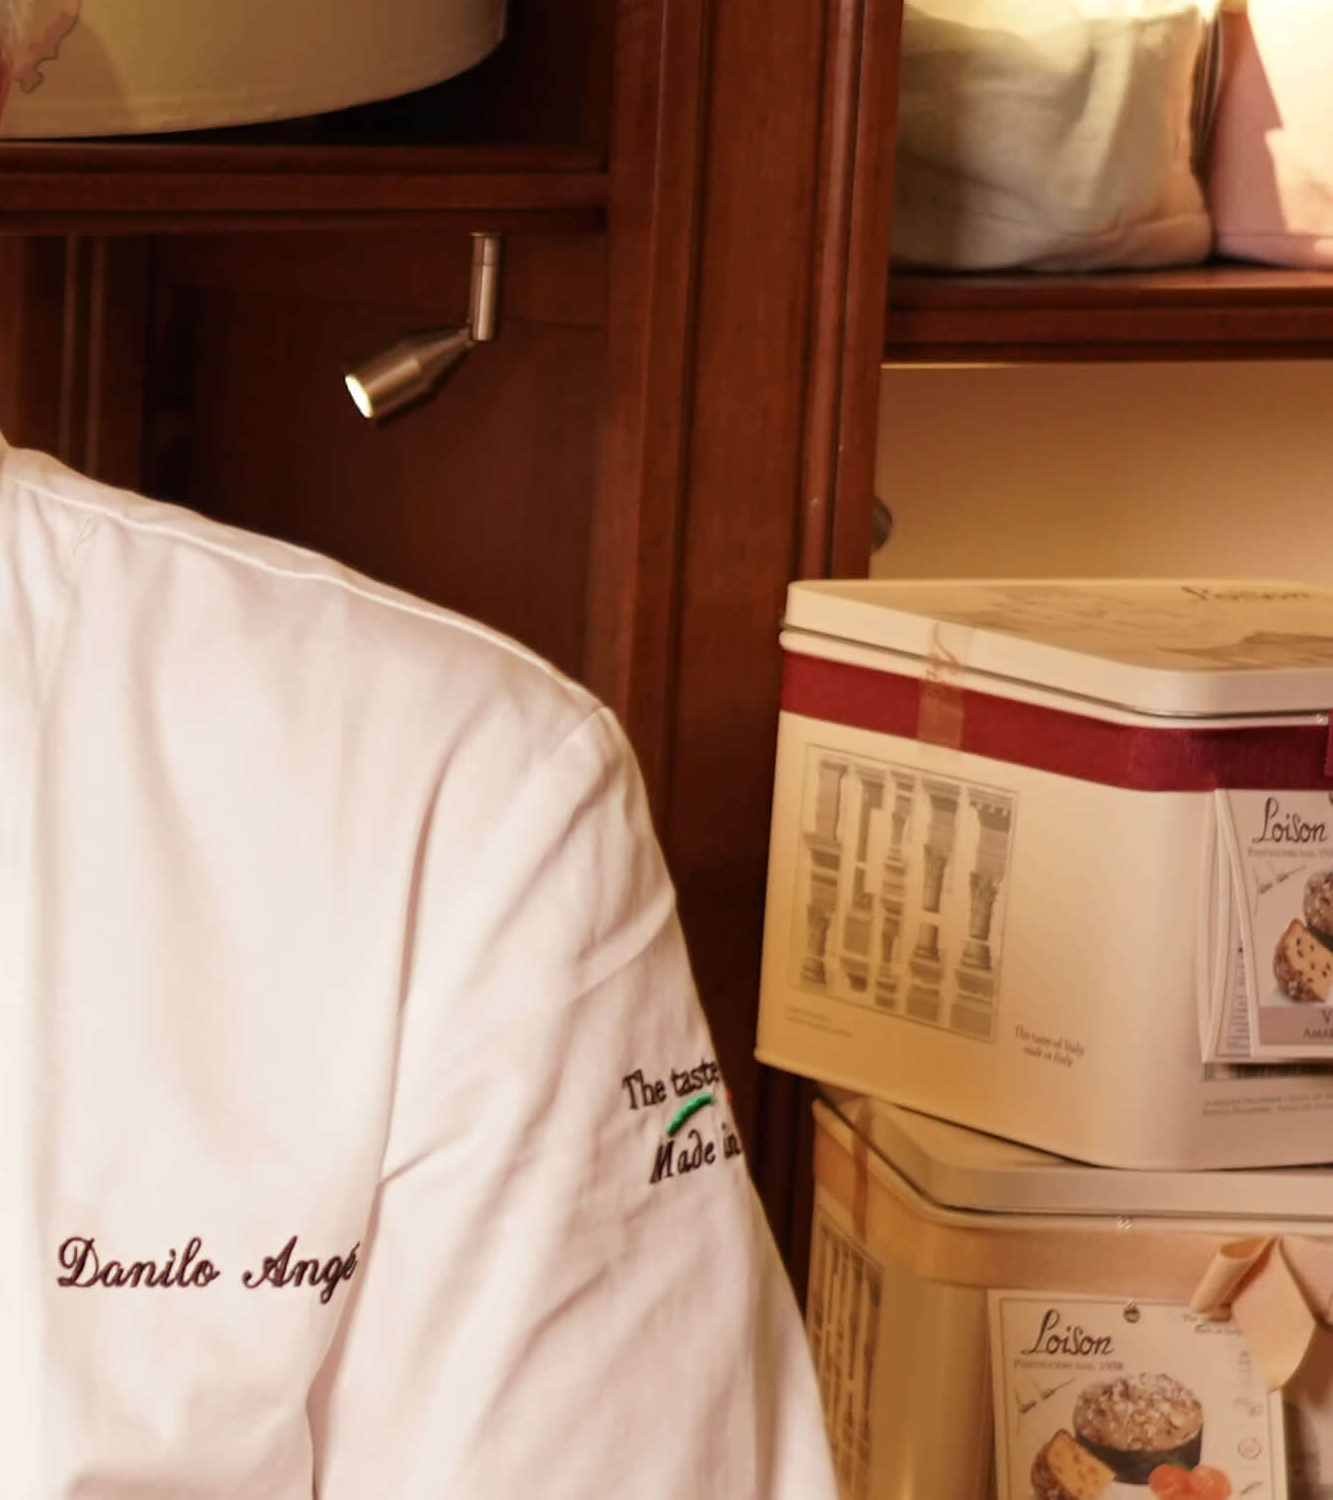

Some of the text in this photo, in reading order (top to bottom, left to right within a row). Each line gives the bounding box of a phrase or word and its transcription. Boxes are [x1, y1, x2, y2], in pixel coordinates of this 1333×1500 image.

[1252, 796, 1330, 843] Loison
[621, 1067, 667, 1110] The
[649, 1128, 716, 1184] Made
[57, 1236, 221, 1288] Danilo
[1021, 1308, 1115, 1356] Loison
